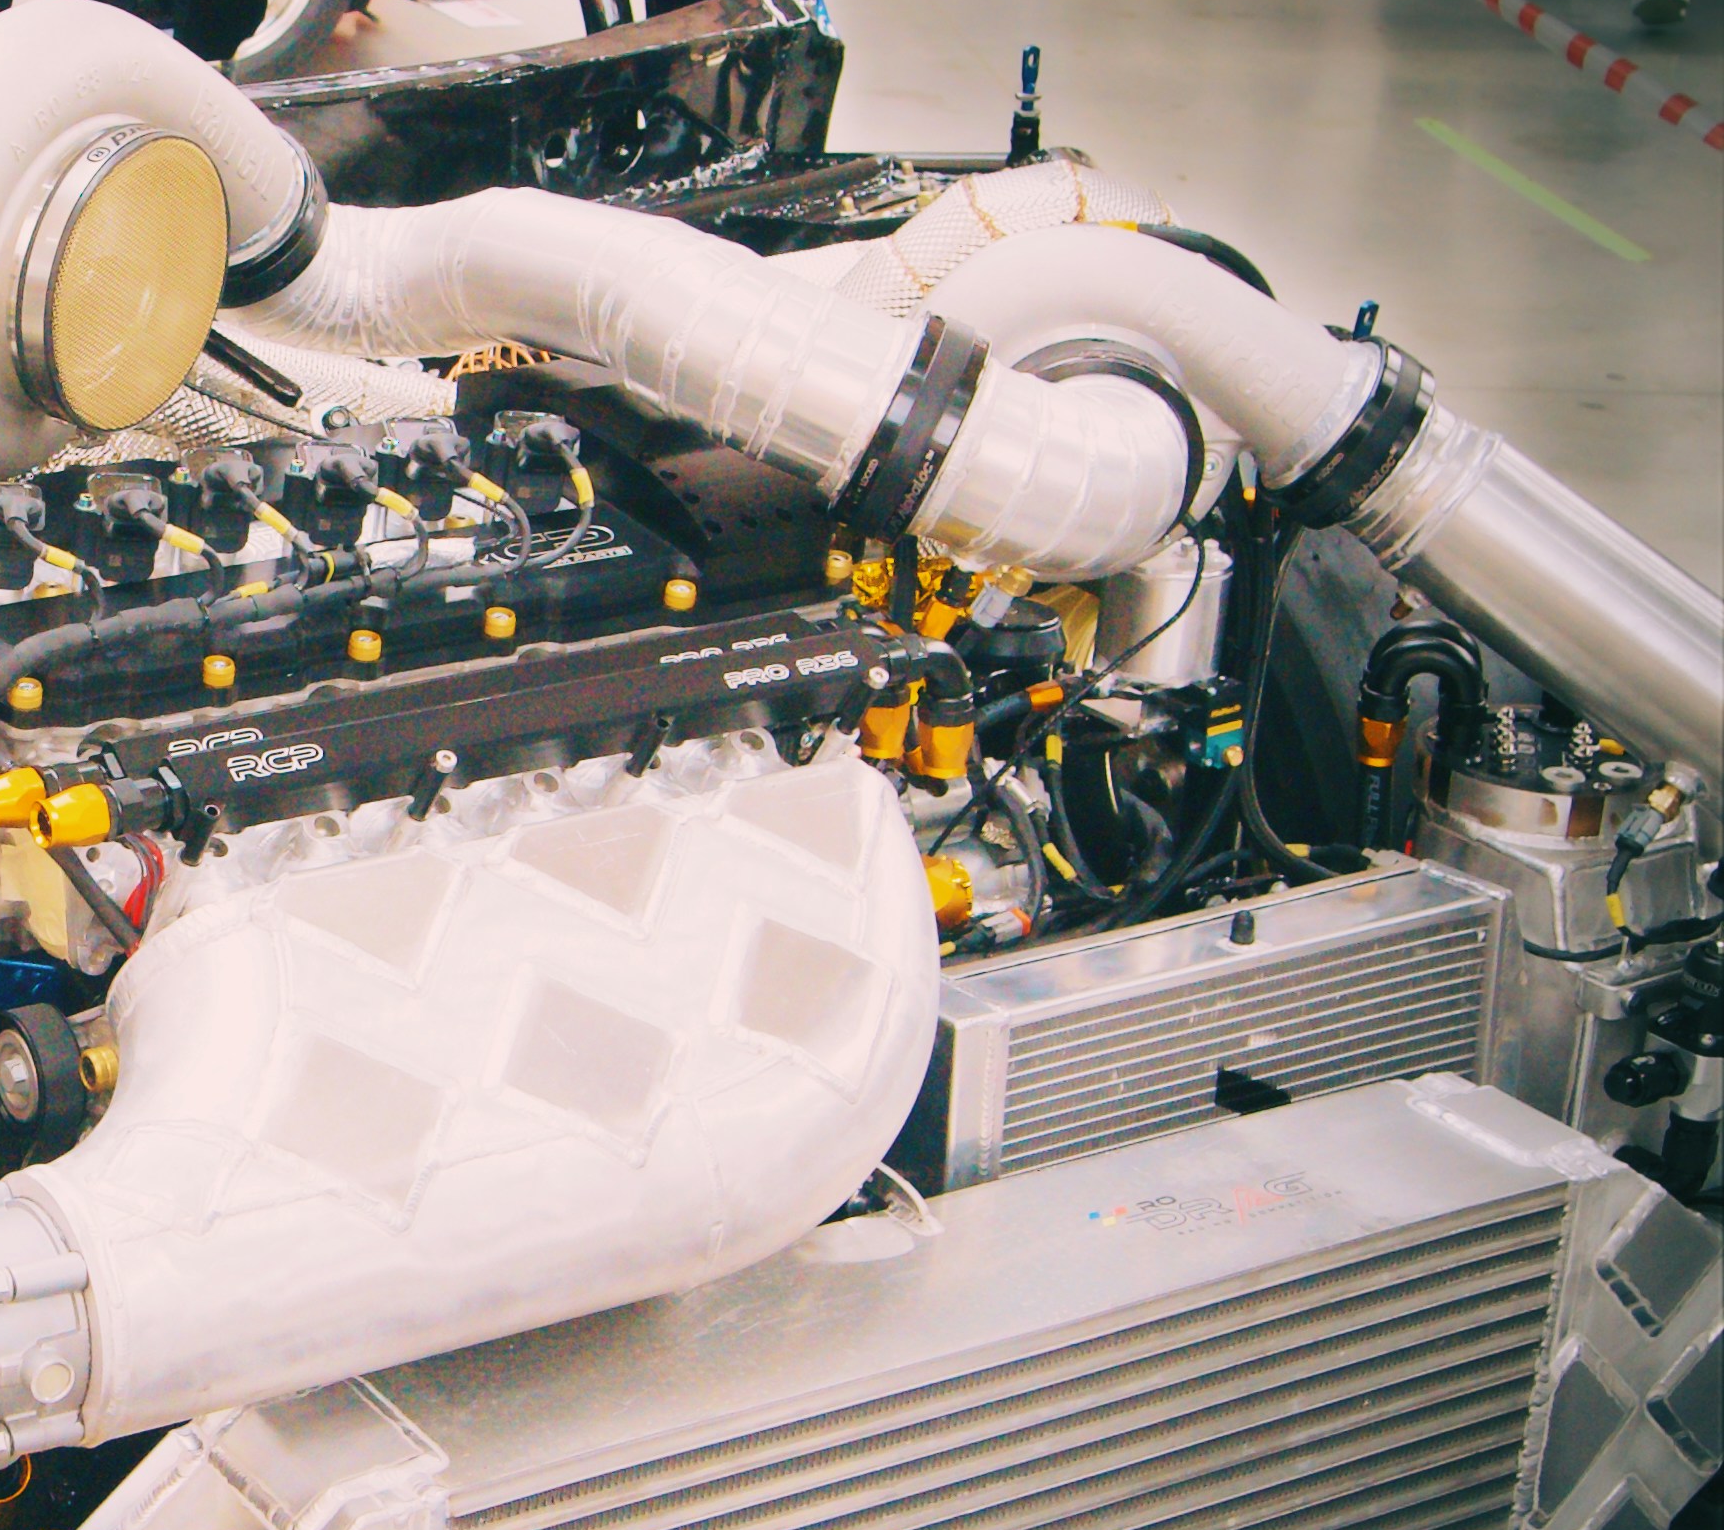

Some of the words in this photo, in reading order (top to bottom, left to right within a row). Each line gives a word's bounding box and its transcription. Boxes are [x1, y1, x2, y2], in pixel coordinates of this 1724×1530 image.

[723, 663, 790, 690] PRO
[226, 742, 324, 782] RCP
[1125, 1170, 1313, 1231] DRAG
[1135, 1195, 1177, 1211] RO
